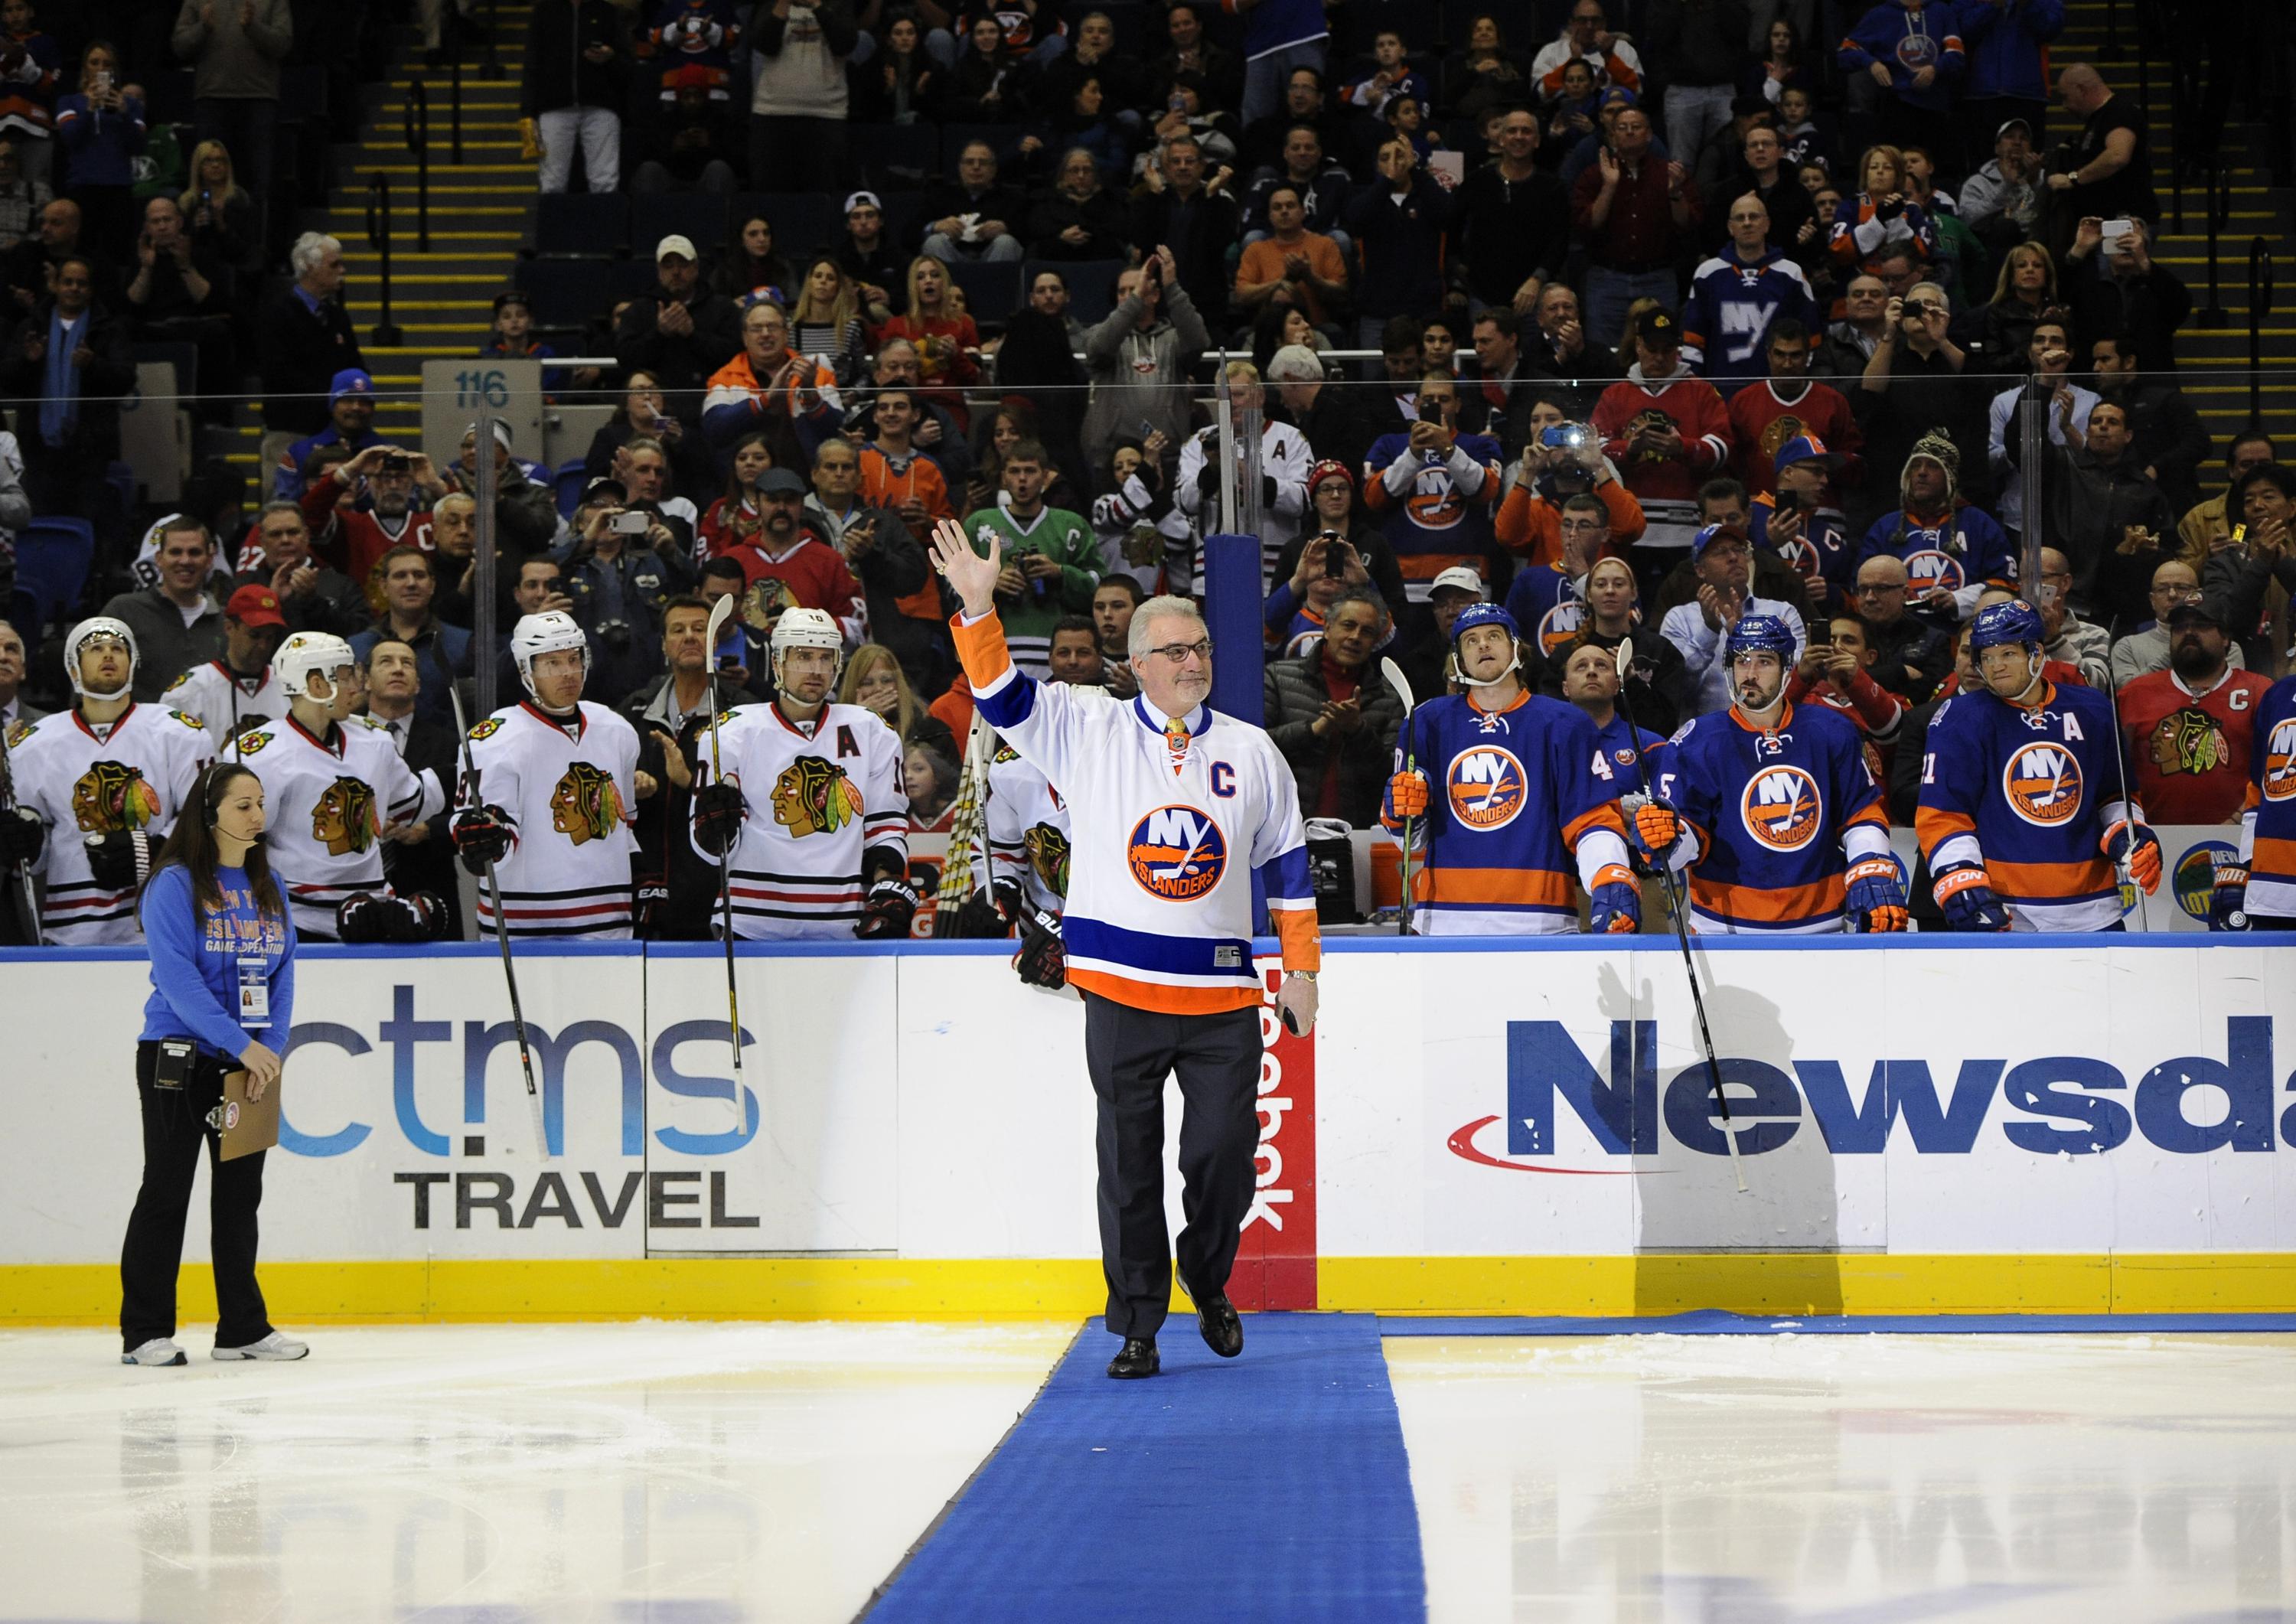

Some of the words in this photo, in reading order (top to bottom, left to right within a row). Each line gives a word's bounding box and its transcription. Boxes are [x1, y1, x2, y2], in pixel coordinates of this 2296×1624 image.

[1721, 301, 1779, 364] NY
[455, 370, 508, 408] 116
[1417, 471, 1453, 502] NY
[1067, 528, 1081, 551] C
[236, 546, 266, 572] 27
[1911, 555, 1950, 585] NY
[2229, 689, 2249, 710] C
[837, 725, 861, 758] A
[2063, 712, 2084, 741] A
[1209, 761, 1237, 799] C
[1462, 752, 1509, 790] NY
[1591, 749, 1614, 781] 4
[2021, 748, 2066, 784] NY
[1758, 771, 1805, 810] NY
[2017, 791, 2079, 817] ISLANDERS
[1459, 797, 1516, 823] ISLANDERS
[1147, 809, 1212, 852] NY
[1754, 811, 1815, 843] ISLANDERS
[1135, 860, 1215, 896] ISLANDERS
[1844, 863, 1895, 885] CCM
[206, 940, 236, 953] GAME
[1507, 1015, 2296, 1155] Newsd
[393, 1171, 761, 1229] TRAVEL
